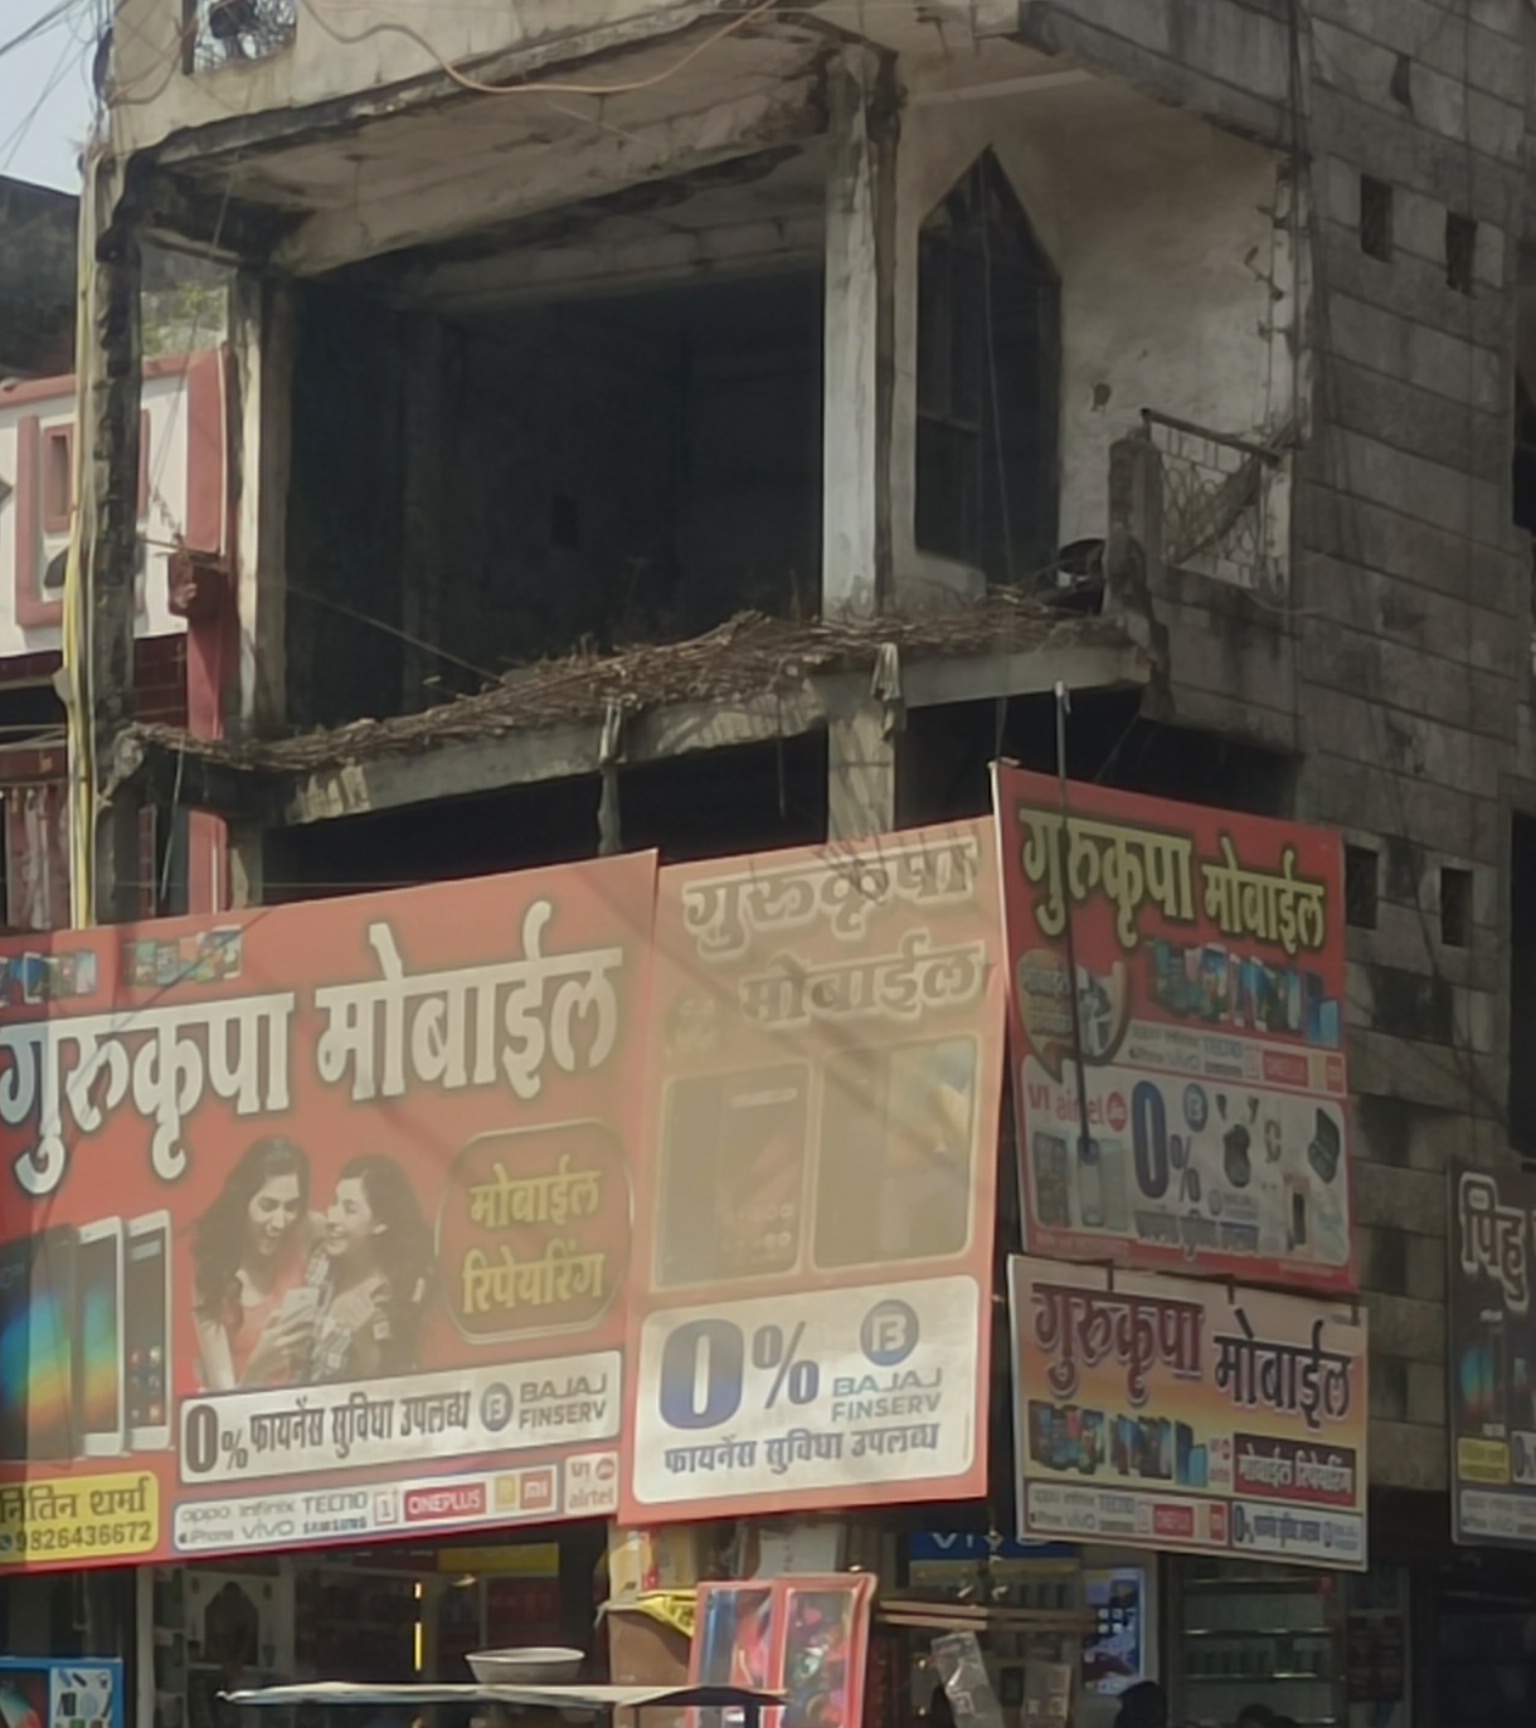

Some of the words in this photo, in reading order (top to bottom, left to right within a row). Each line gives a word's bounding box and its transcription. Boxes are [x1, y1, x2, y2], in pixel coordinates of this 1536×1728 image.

[682, 835, 979, 961] गुरुकृपा
[1018, 808, 1194, 948] गुरुकृपा
[1202, 836, 1324, 954] मोबाईल
[315, 902, 624, 1099] मोबाईल
[739, 928, 985, 1031] मोबाईल
[469, 1154, 601, 1228] मोबाईल
[462, 1238, 606, 1314] रिपेयरिंग
[520, 1373, 607, 1401] BAJAJ
[658, 1318, 820, 1430] 0%
[832, 1367, 942, 1398] BAJAJ
[1031, 1282, 1205, 1404] गुरुकृपा
[1213, 1307, 1354, 1430] मोबाईल
[185, 1403, 249, 1474] 0%
[330, 1391, 393, 1458] सुविधा
[519, 1401, 607, 1429] FINSERV
[831, 1393, 942, 1422] FINSERV
[764, 1428, 842, 1475] सुविधा
[89, 1475, 150, 1517] शर्मा
[406, 1488, 483, 1517] ONEPLUS
[15, 1520, 152, 1553] 9826436672
